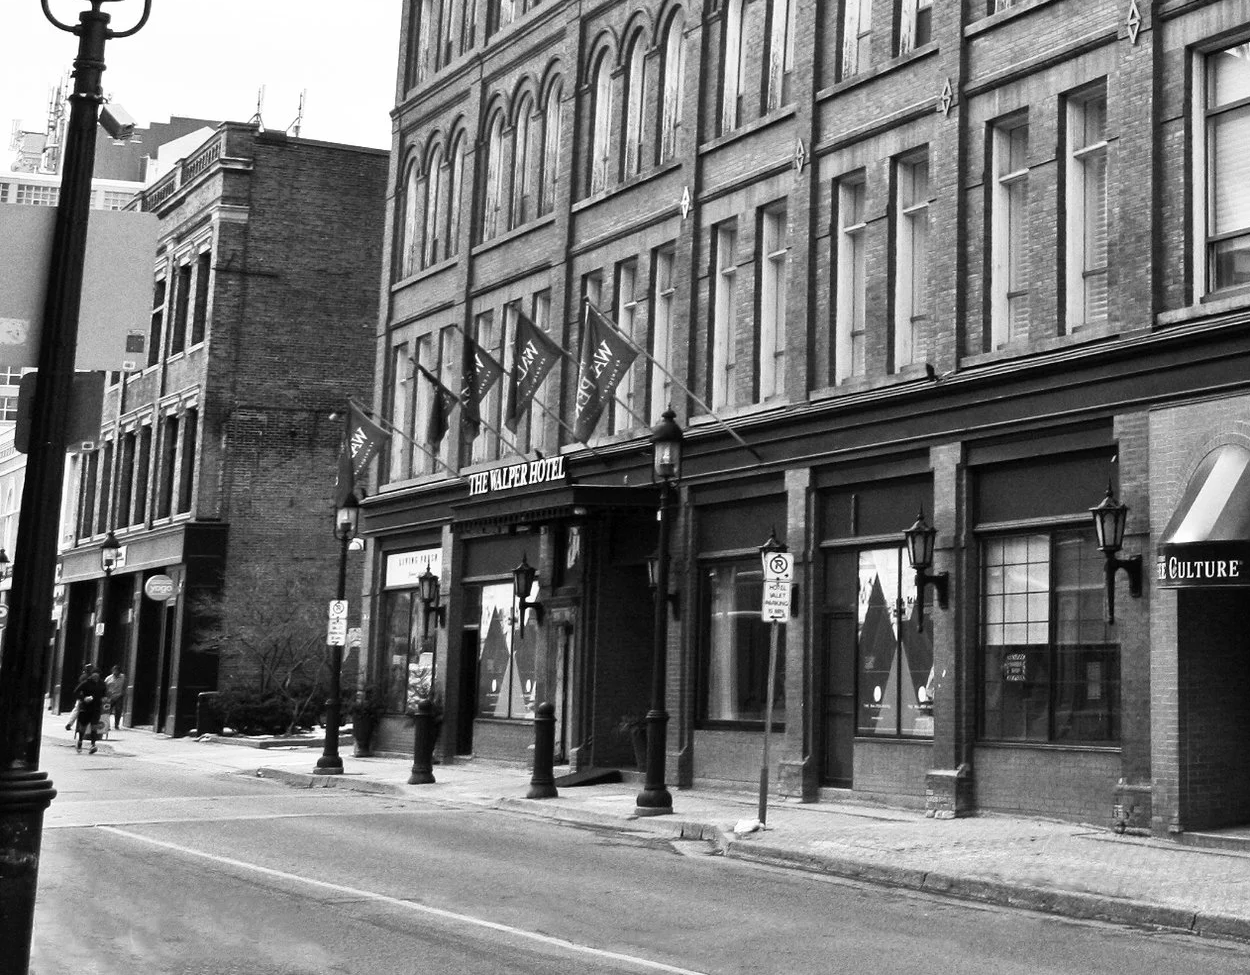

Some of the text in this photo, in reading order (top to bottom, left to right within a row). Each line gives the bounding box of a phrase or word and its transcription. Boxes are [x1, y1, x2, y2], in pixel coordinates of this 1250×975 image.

[468, 455, 566, 496] THE WALPER HOTEL
[1169, 556, 1240, 579] CULTURE
